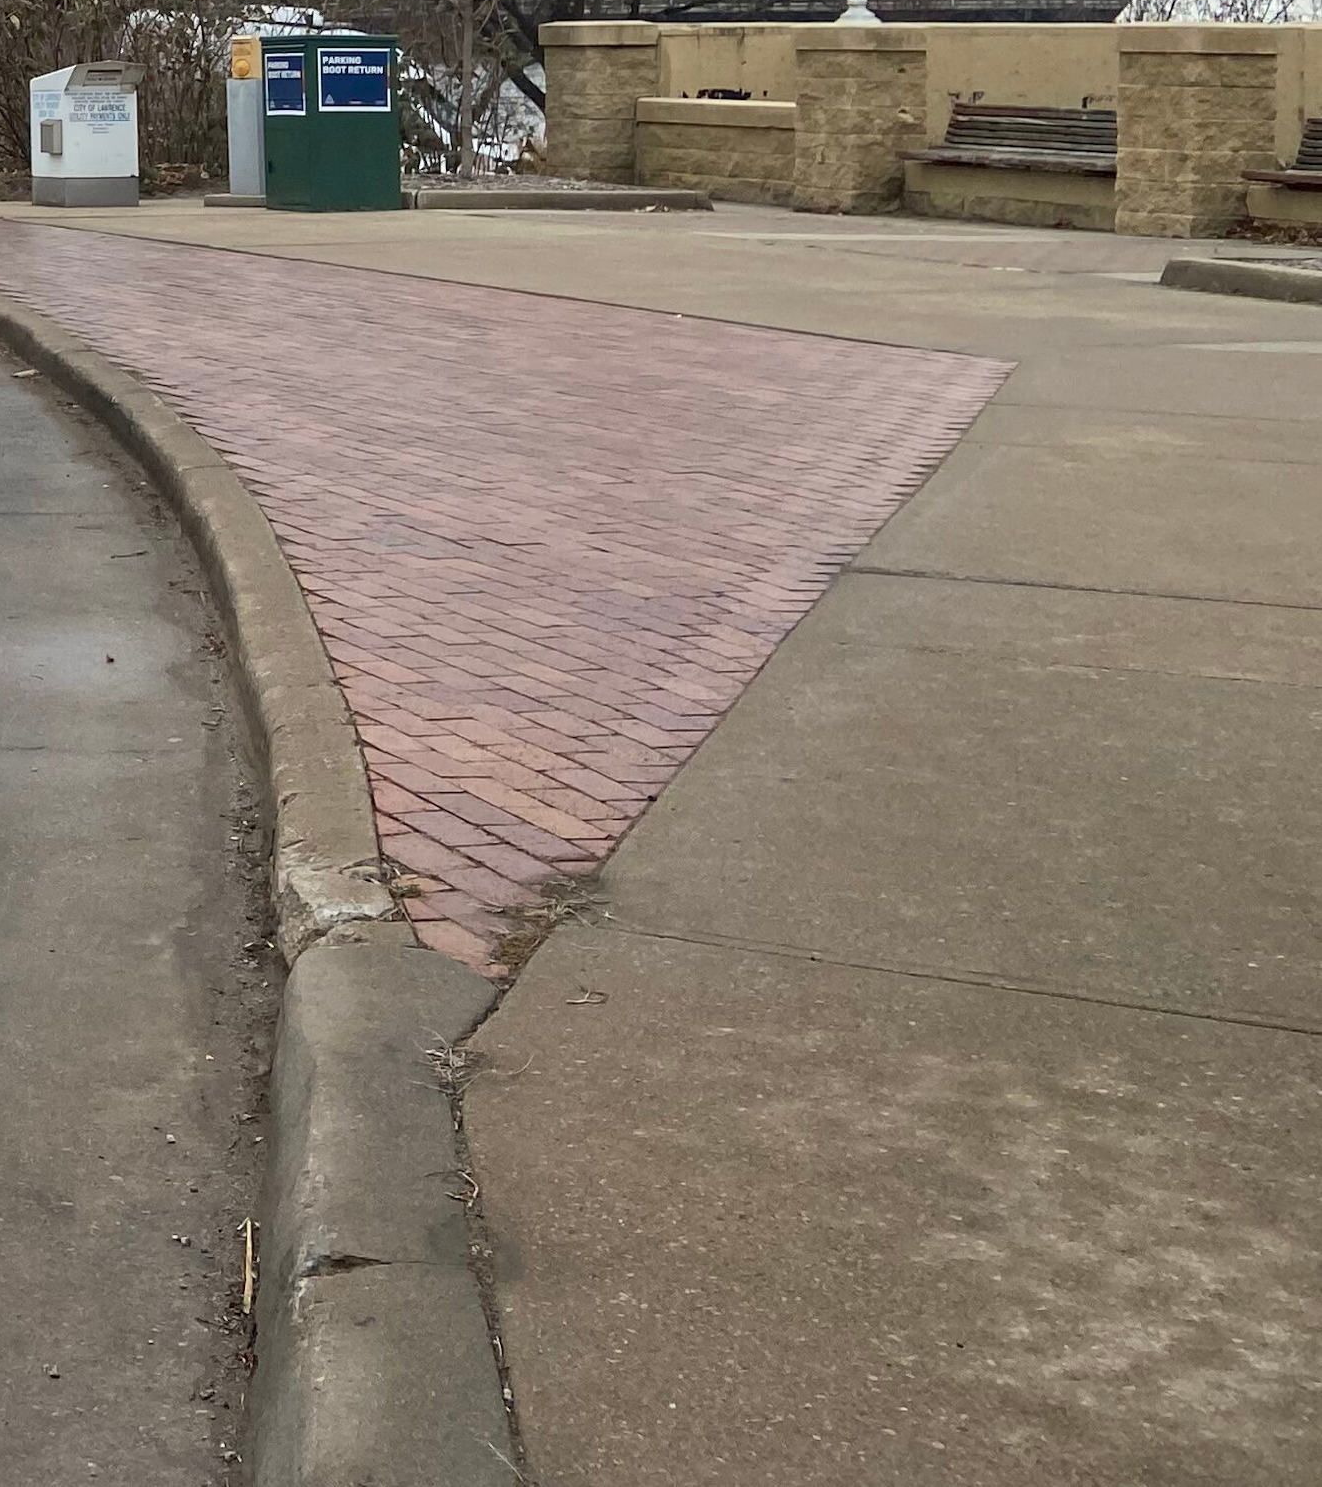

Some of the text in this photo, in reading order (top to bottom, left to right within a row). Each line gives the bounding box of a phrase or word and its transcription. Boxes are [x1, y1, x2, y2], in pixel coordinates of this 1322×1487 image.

[323, 56, 362, 65] PARKING
[323, 66, 383, 74] BOOT RETURN
[74, 103, 126, 112] CITY OF LAWRENCE
